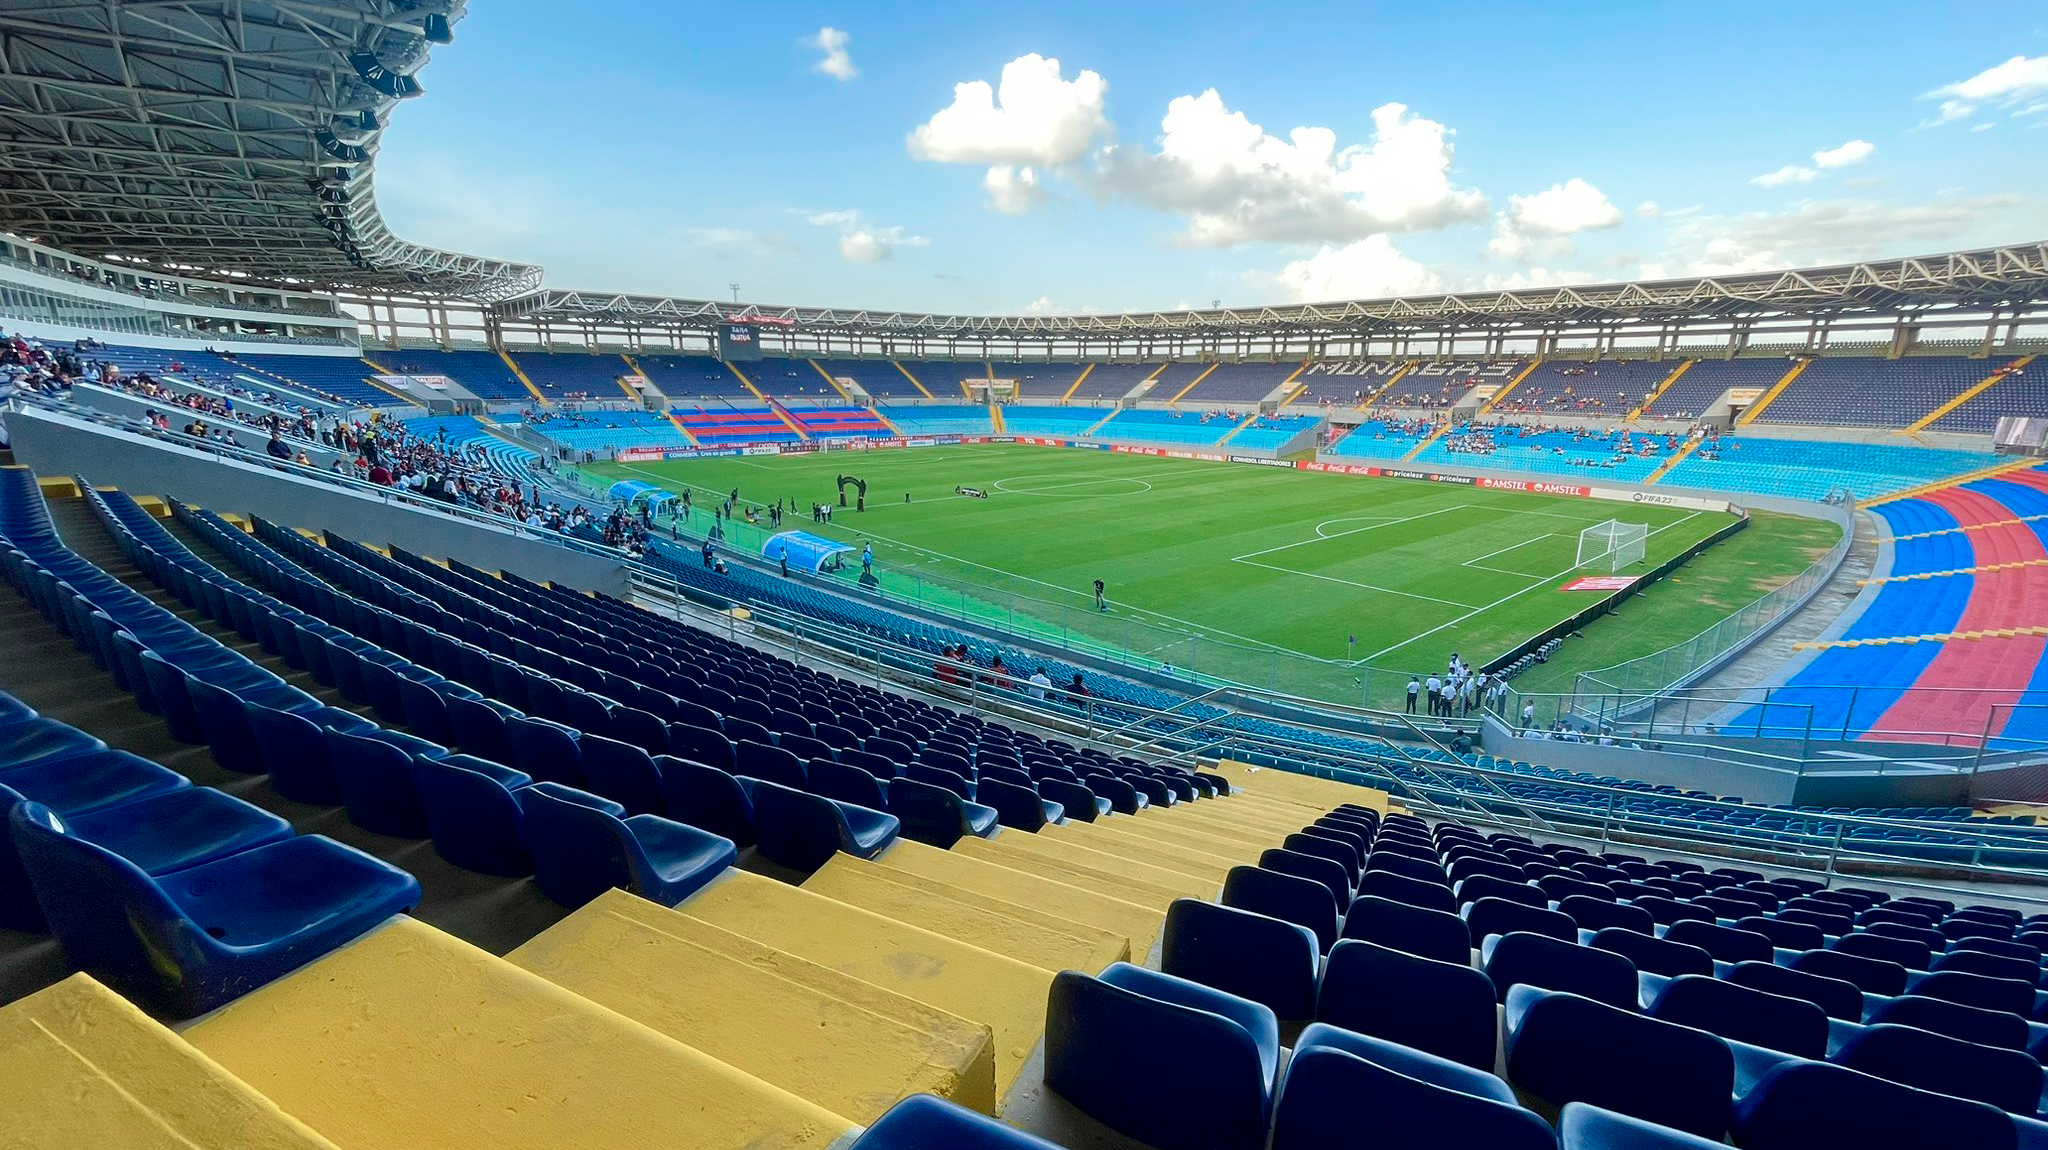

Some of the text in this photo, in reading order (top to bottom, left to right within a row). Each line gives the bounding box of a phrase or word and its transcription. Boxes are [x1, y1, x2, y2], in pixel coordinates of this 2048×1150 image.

[1232, 456, 1257, 465] CONMEBOL
[1258, 458, 1291, 467] LIBERTADORES
[1394, 470, 1470, 484] priceless priceless
[1492, 479, 1581, 496] AMSTEL AMSTEL
[1643, 494, 1673, 504] FIFA 23
